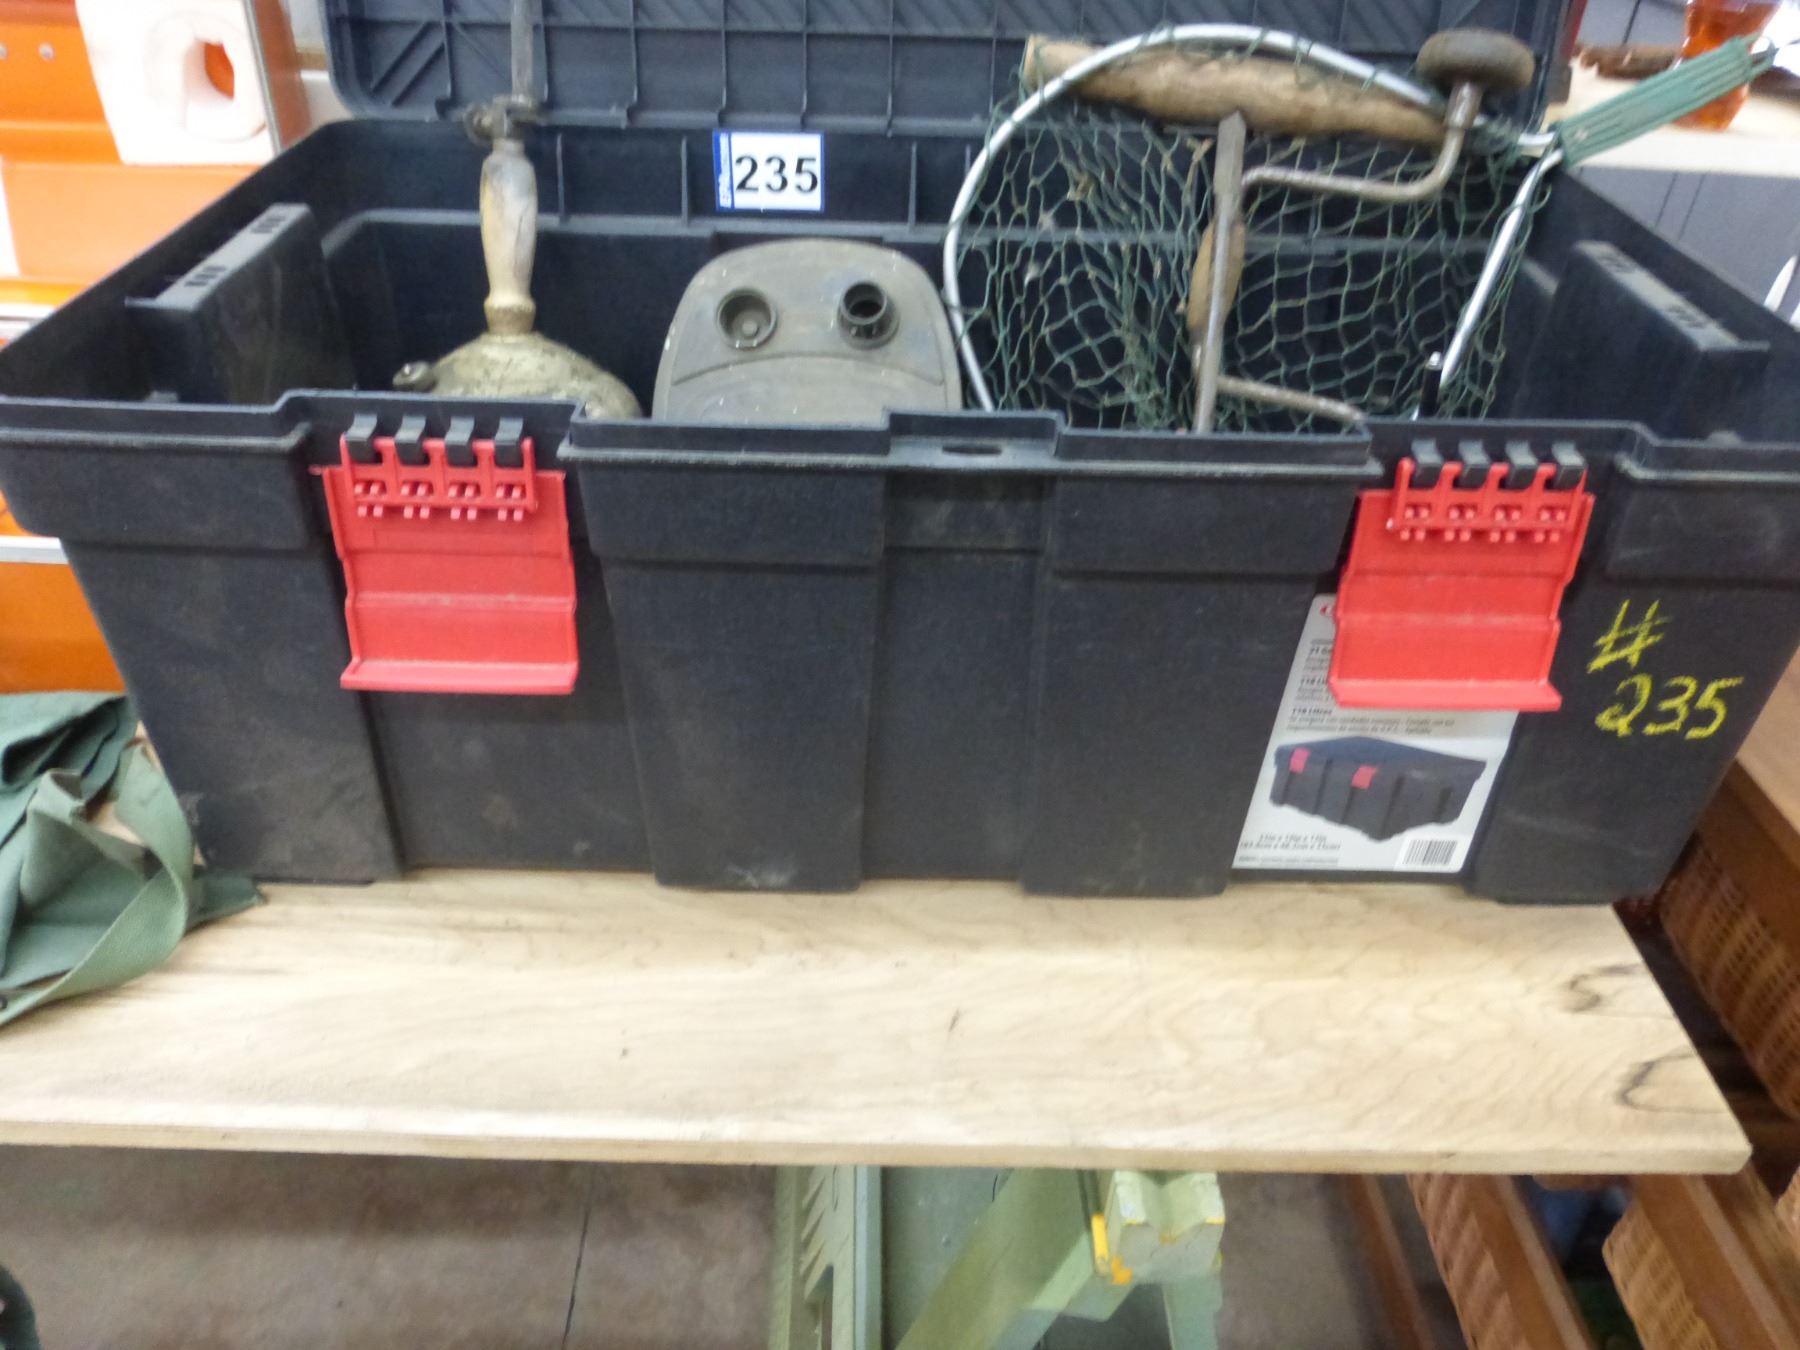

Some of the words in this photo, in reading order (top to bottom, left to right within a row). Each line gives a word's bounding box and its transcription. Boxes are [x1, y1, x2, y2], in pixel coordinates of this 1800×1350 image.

[735, 155, 819, 194] 235
[1587, 599, 1670, 674] #
[1595, 673, 1745, 740] 235
